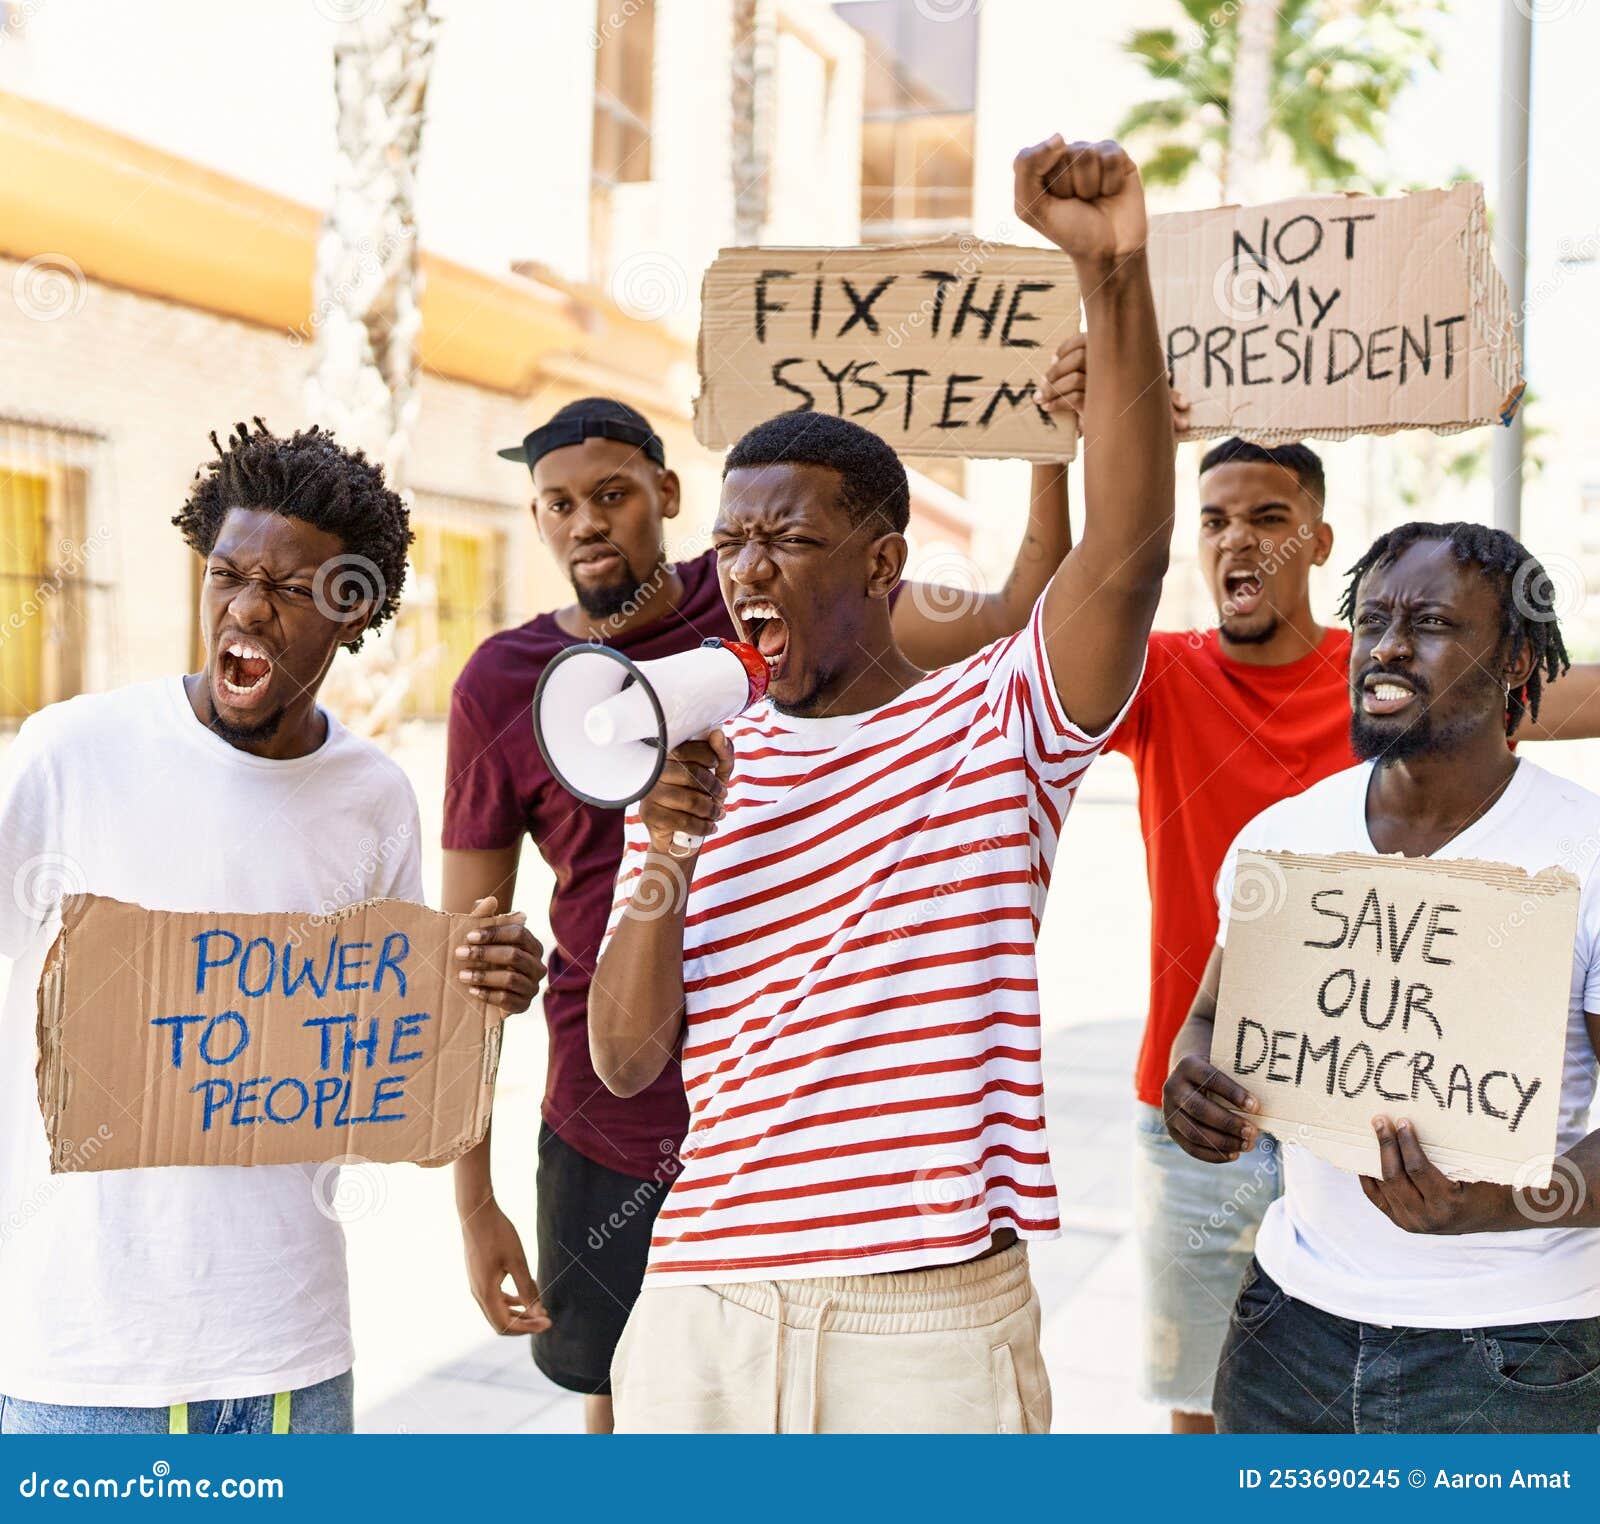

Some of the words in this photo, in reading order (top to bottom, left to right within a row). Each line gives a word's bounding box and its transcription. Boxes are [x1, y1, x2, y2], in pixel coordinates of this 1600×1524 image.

[1232, 214, 1375, 275] NOT
[753, 260, 899, 344] FIX
[917, 270, 1055, 348] THE
[1167, 314, 1466, 389] PRESIDENT
[772, 357, 1057, 431] SYSTEM
[1303, 888, 1461, 966] SAVE
[191, 929, 411, 999] POWER
[1317, 968, 1443, 1040] OUR
[151, 1010, 251, 1070] TO
[303, 1012, 432, 1074] THE
[1233, 1016, 1542, 1132] DEMOCRACY
[190, 1076, 408, 1132] PEOPLE
